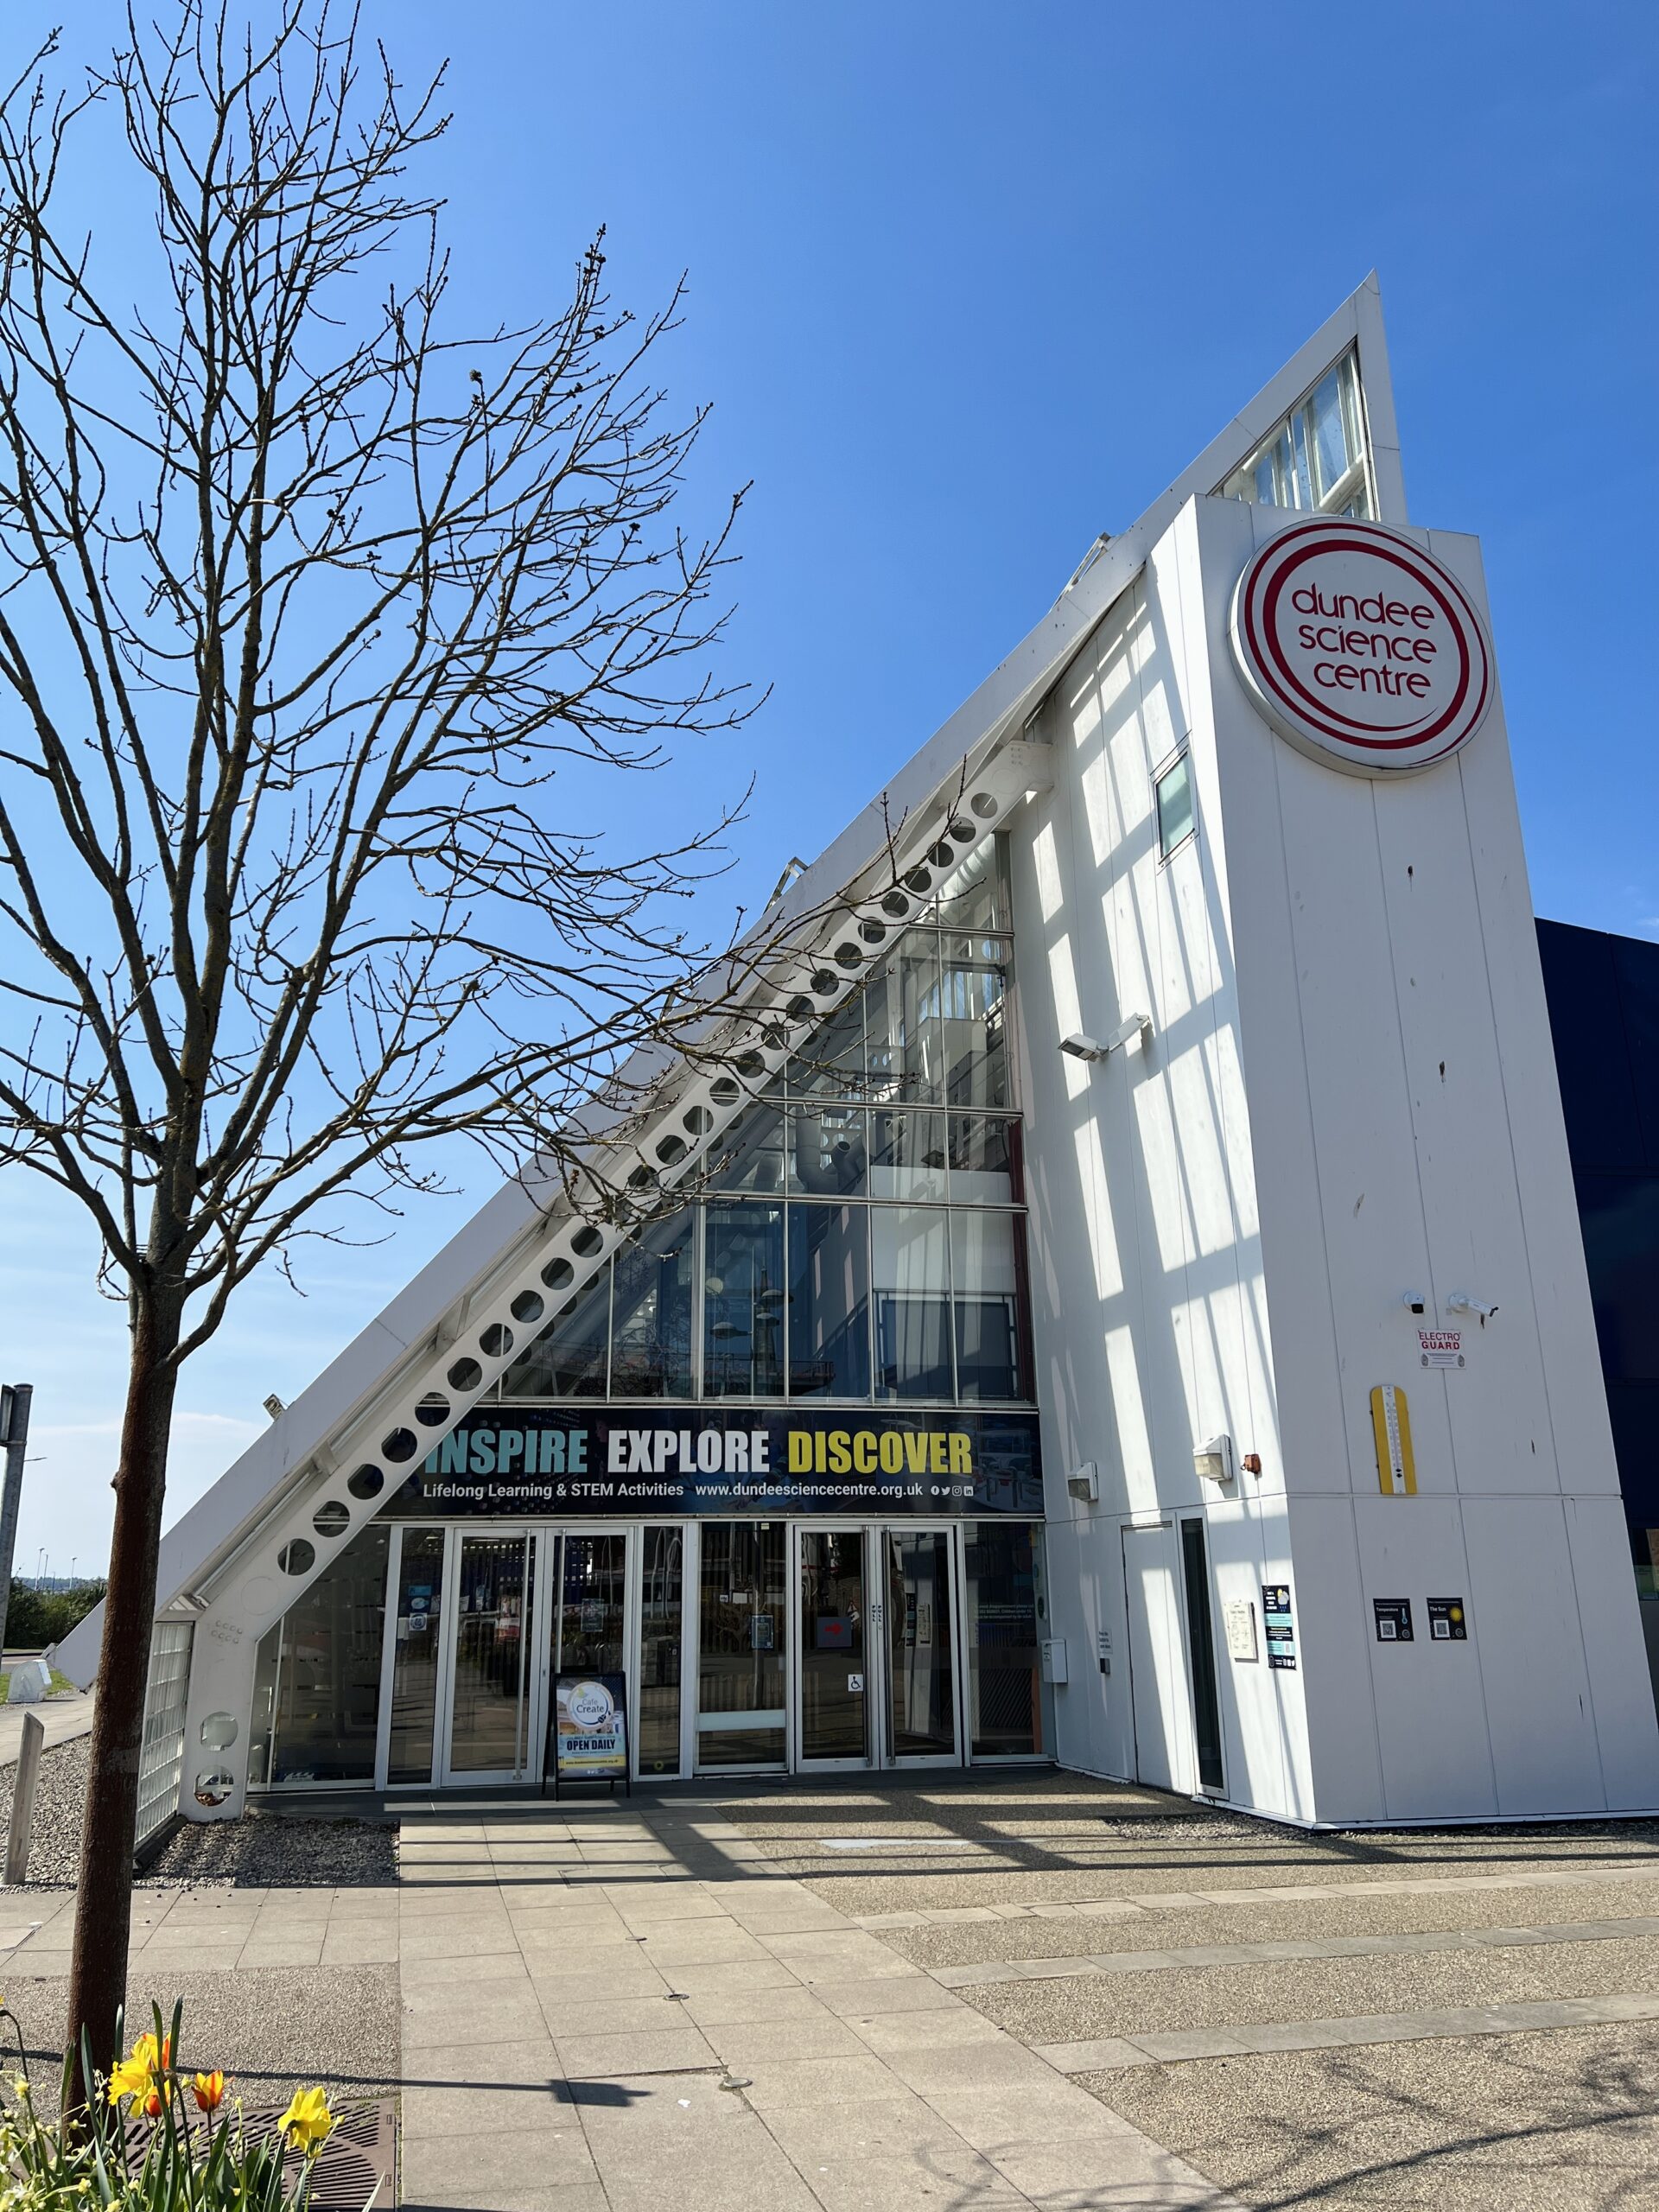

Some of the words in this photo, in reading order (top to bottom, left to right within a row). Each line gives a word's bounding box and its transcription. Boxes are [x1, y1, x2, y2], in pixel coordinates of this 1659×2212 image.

[1292, 582, 1434, 629] dundee
[1299, 625, 1437, 664] science
[1313, 663, 1431, 698] centre
[1419, 1332, 1460, 1341] ELECTRO
[1421, 1341, 1460, 1350] GUARD
[607, 1429, 770, 1473] EXPLORE
[788, 1430, 973, 1474] DISCOVER
[423, 1483, 484, 1500] Lifelong
[488, 1484, 552, 1500] Learning
[556, 1484, 567, 1497] &
[571, 1484, 613, 1497] STEM
[617, 1483, 684, 1497] Activities
[695, 1482, 924, 1499] www.dundeesciencecentre.org.uk
[575, 1705, 605, 1713] Create
[566, 1739, 589, 1751] OPEN
[591, 1738, 616, 1750] DAILY
